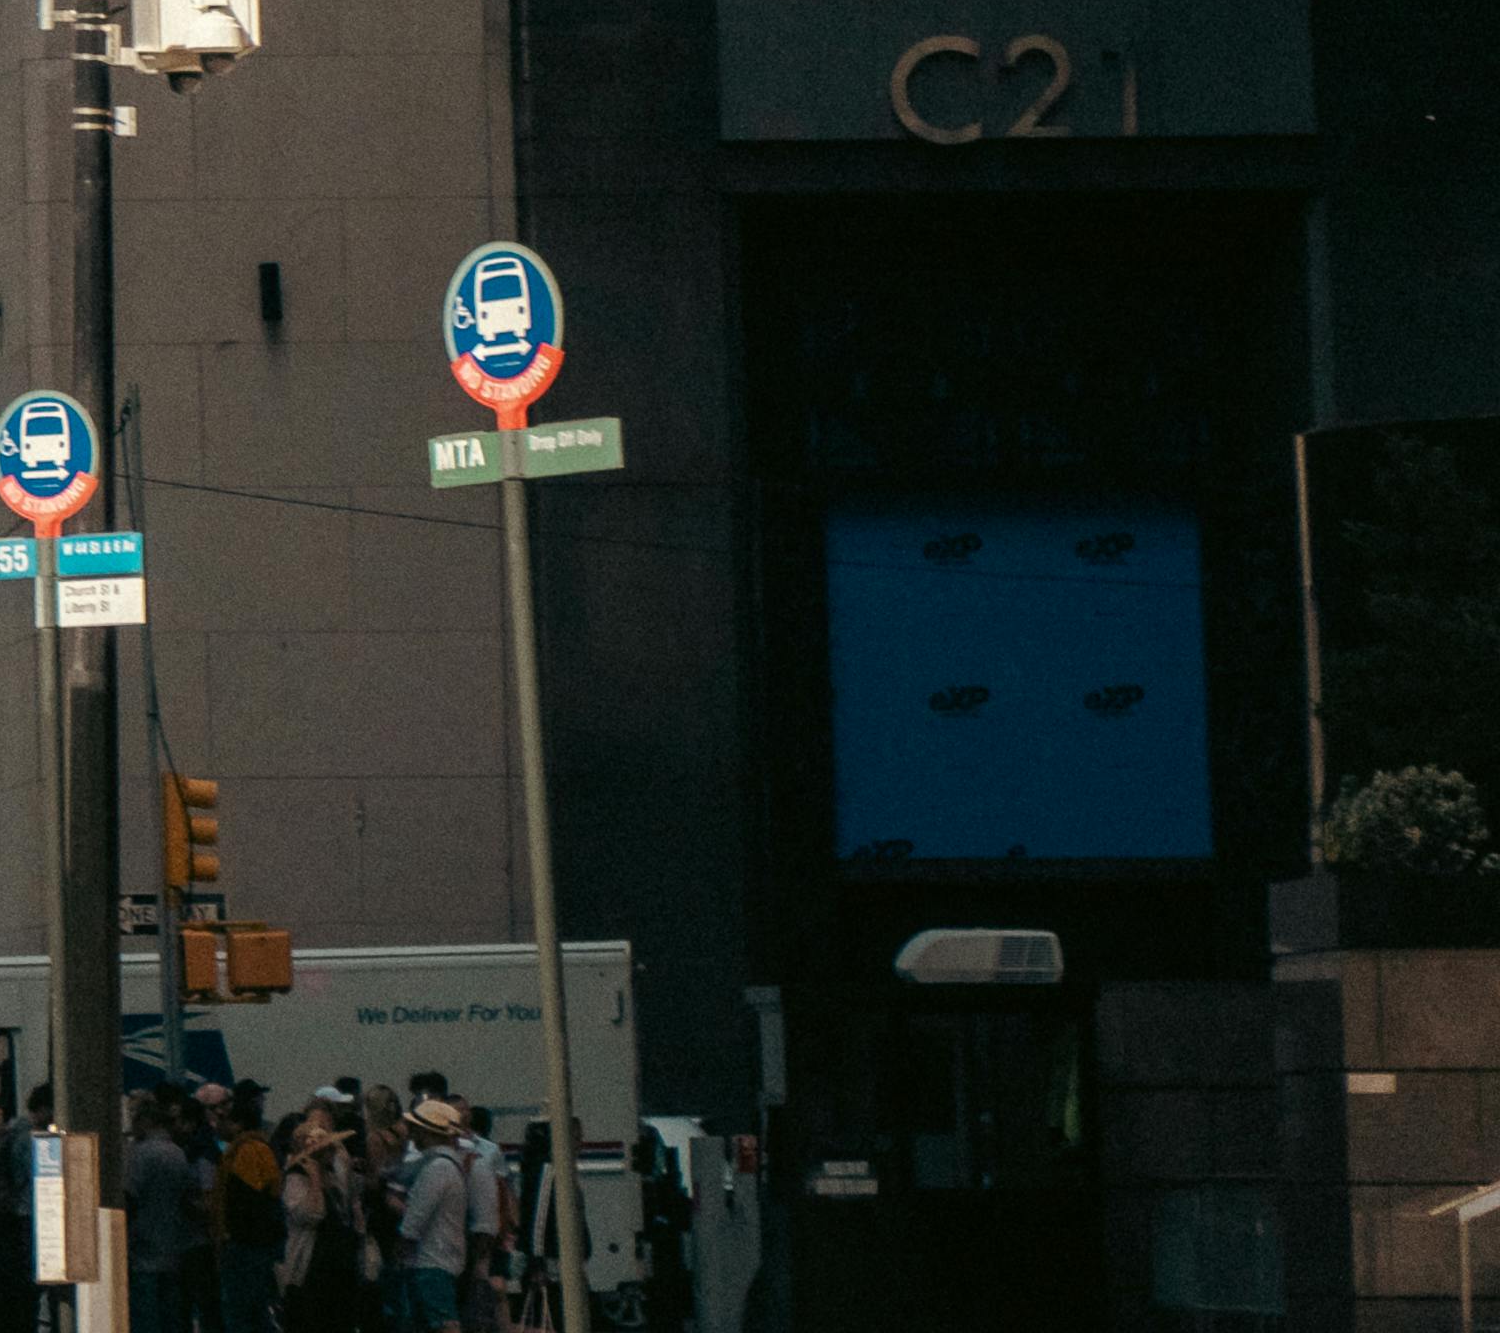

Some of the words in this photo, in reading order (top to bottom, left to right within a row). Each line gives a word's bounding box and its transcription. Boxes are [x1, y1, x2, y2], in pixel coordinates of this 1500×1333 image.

[479, 354, 552, 401] STANDING
[434, 437, 486, 471] MTA
[21, 477, 87, 514] STANDING
[357, 1006, 388, 1025] We
[392, 1006, 461, 1024] Deliver
[467, 1003, 501, 1023] For
[505, 1002, 542, 1022] You
